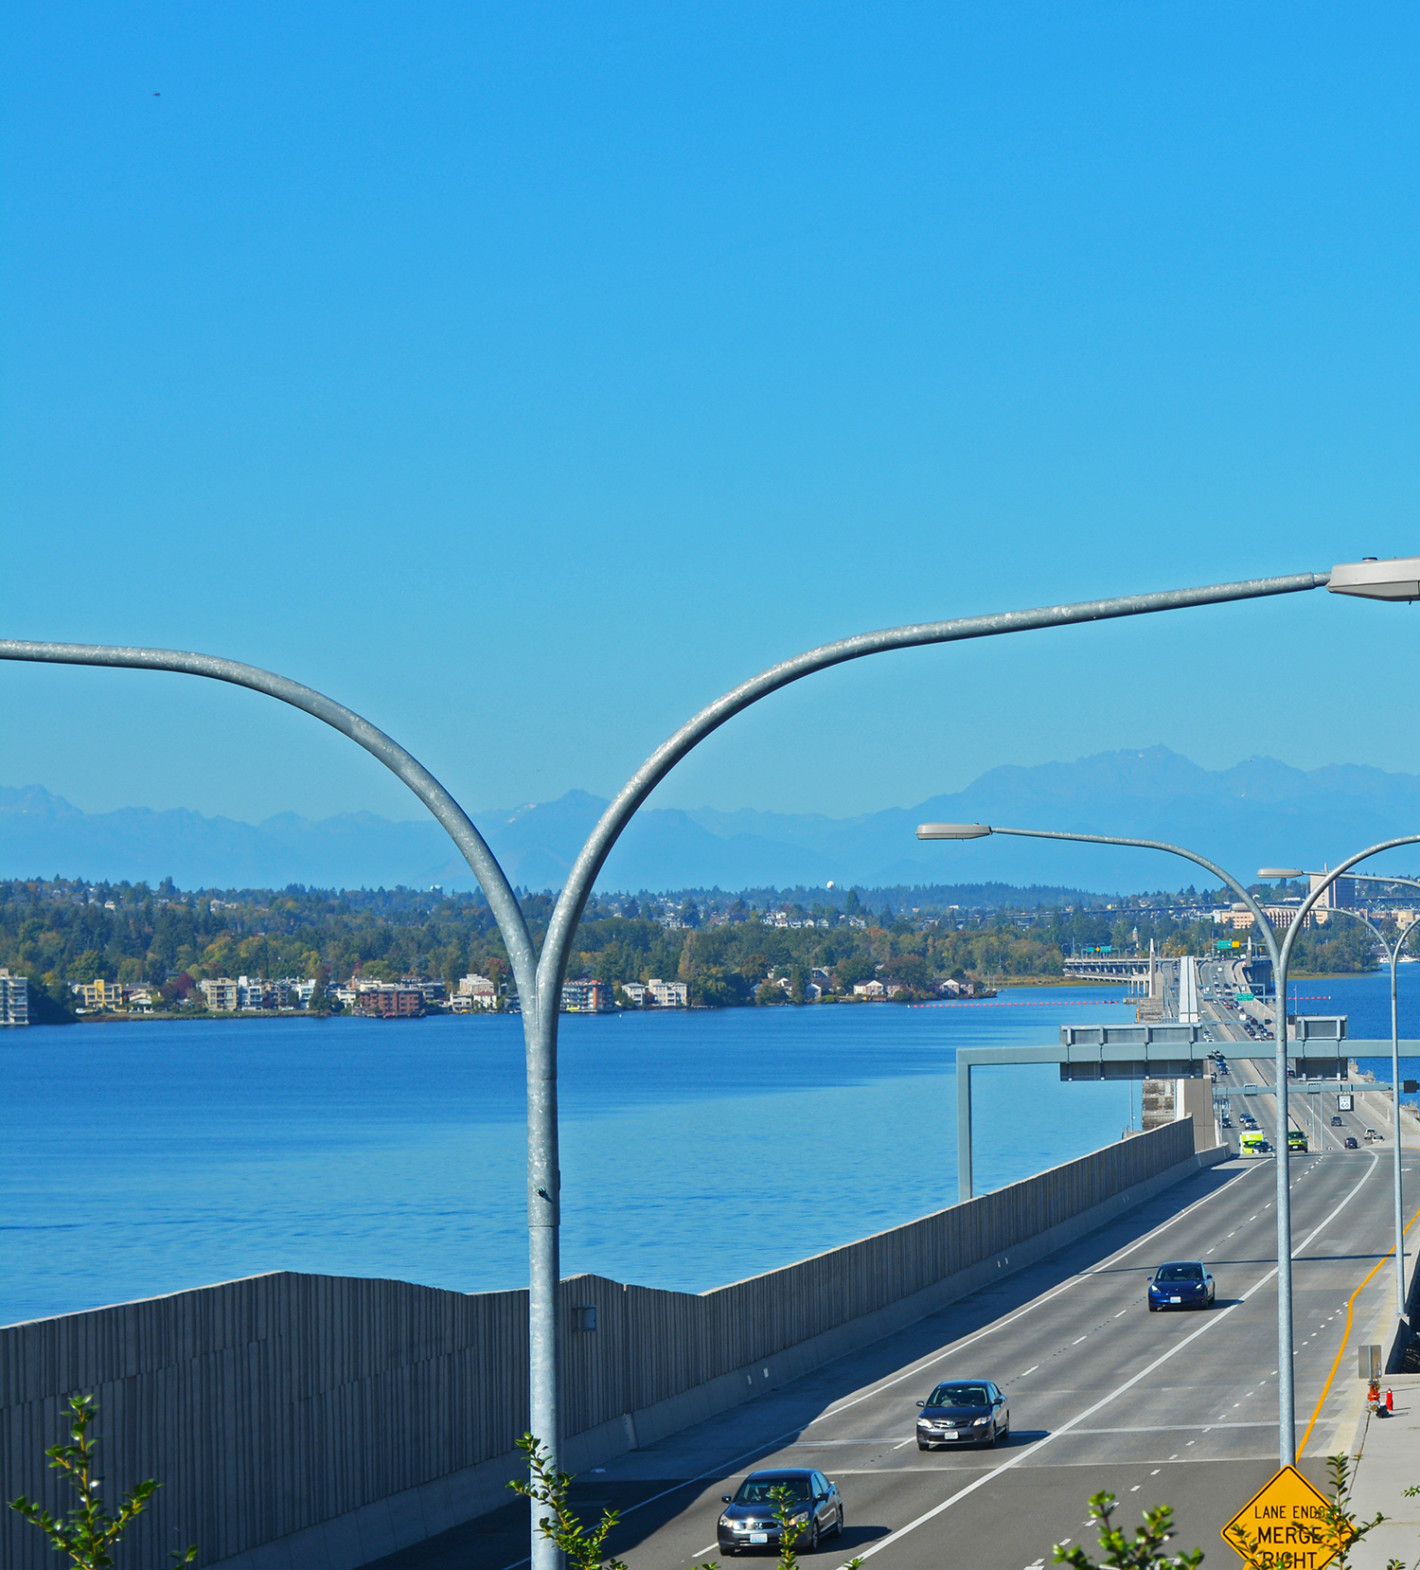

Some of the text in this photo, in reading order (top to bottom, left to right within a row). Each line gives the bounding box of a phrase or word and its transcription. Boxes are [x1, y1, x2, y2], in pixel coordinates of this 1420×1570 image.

[1254, 1505, 1287, 1519] LANE
[1257, 1526, 1322, 1545] MERGE
[1262, 1551, 1318, 1569] RIGHT
